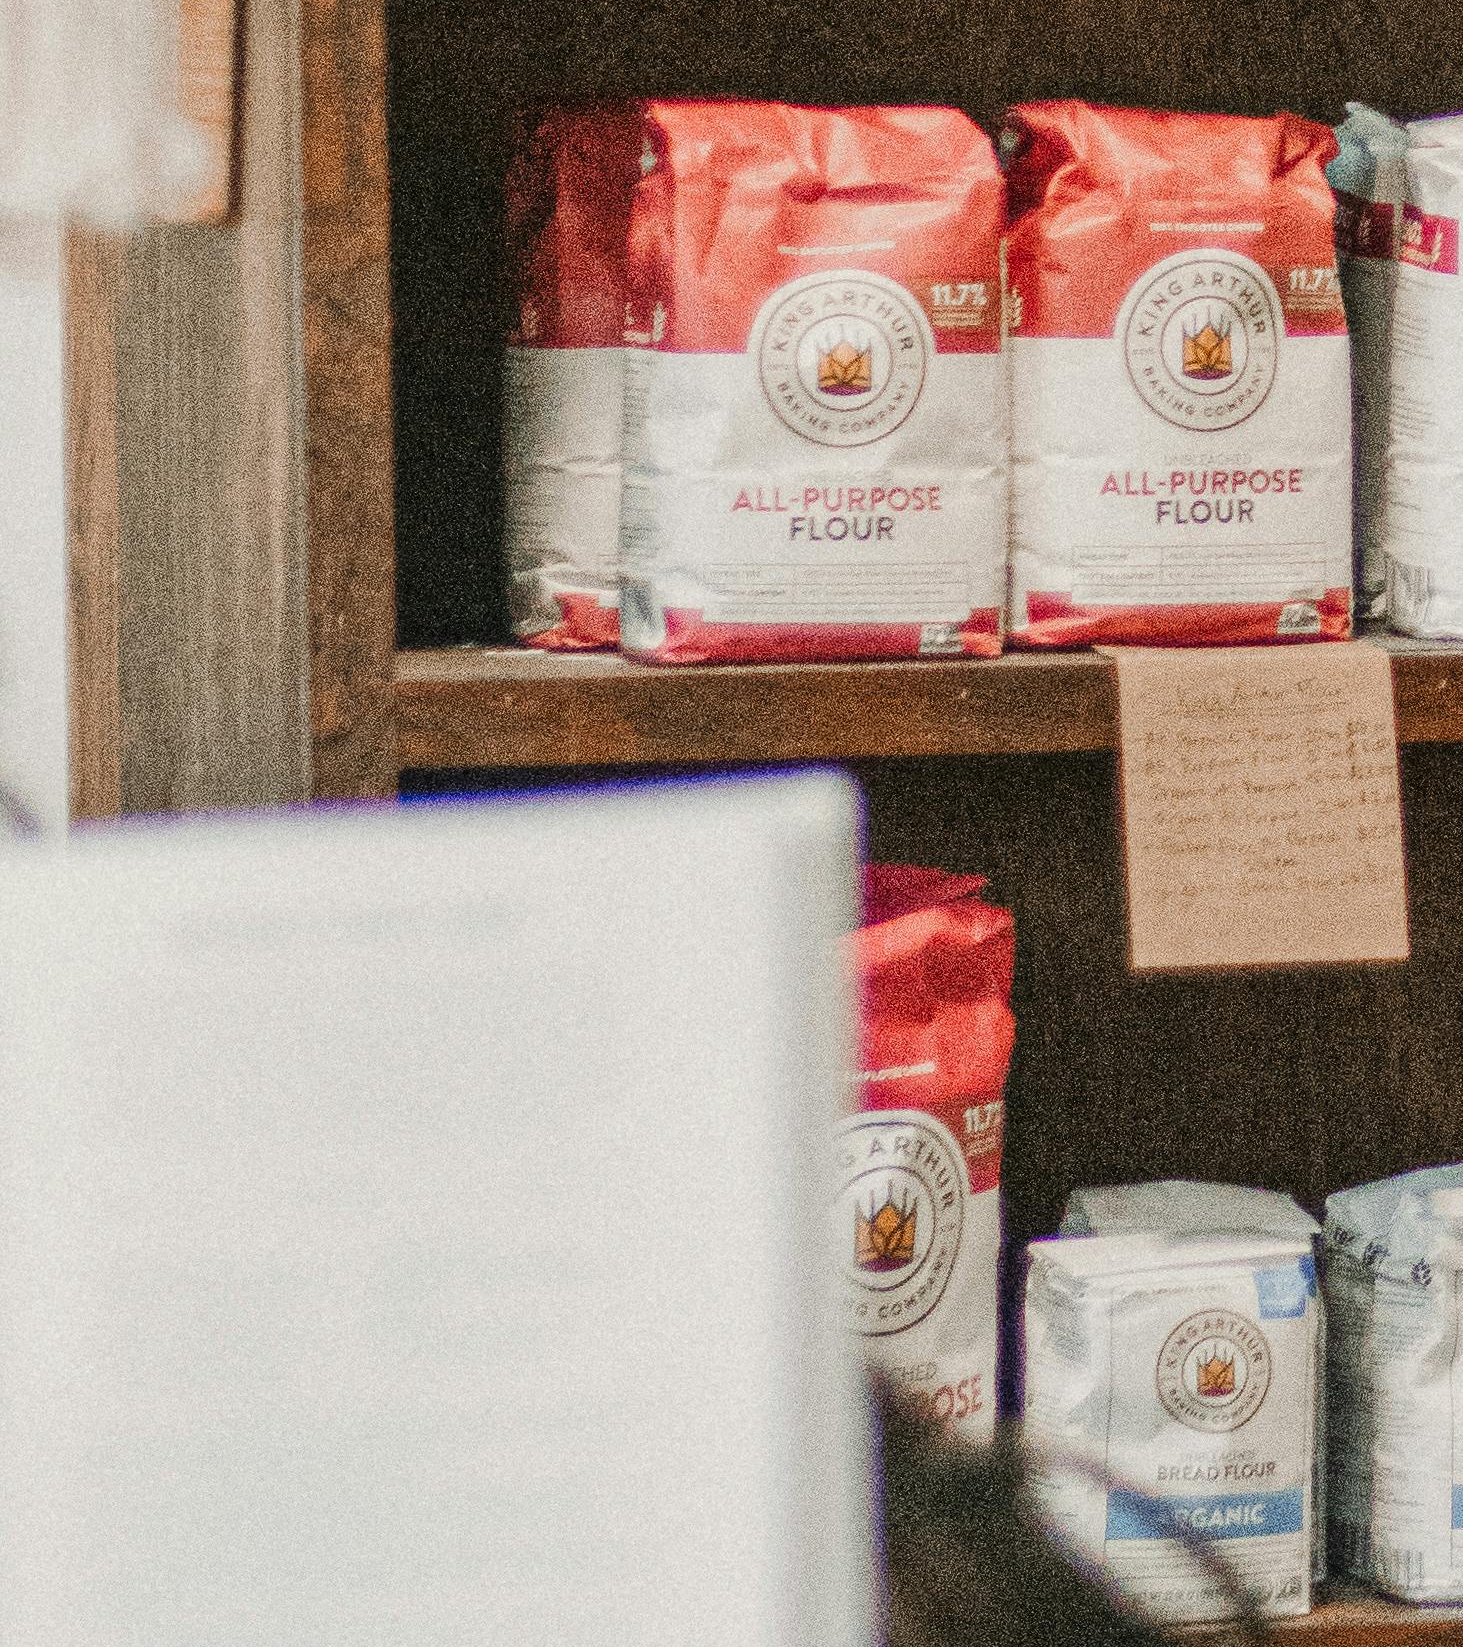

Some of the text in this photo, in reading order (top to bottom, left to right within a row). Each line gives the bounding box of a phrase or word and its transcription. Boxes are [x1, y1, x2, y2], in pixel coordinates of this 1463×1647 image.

[773, 288, 914, 353] KING ARTHUR
[1139, 268, 1266, 335] KING ARTHUR
[839, 380, 911, 435] COMPANY
[1144, 366, 1266, 420] BAKING COMPANY
[733, 486, 942, 512] ALL-PURPOSE
[1101, 468, 1304, 496] ALL-PURPOSE
[790, 516, 895, 541] FLOUR
[1156, 500, 1254, 524] FLOUR
[870, 1136, 955, 1209] ARTHUR
[1202, 1318, 1264, 1363] ARTHUR
[1157, 1462, 1276, 1482] BREAD FLOUR
